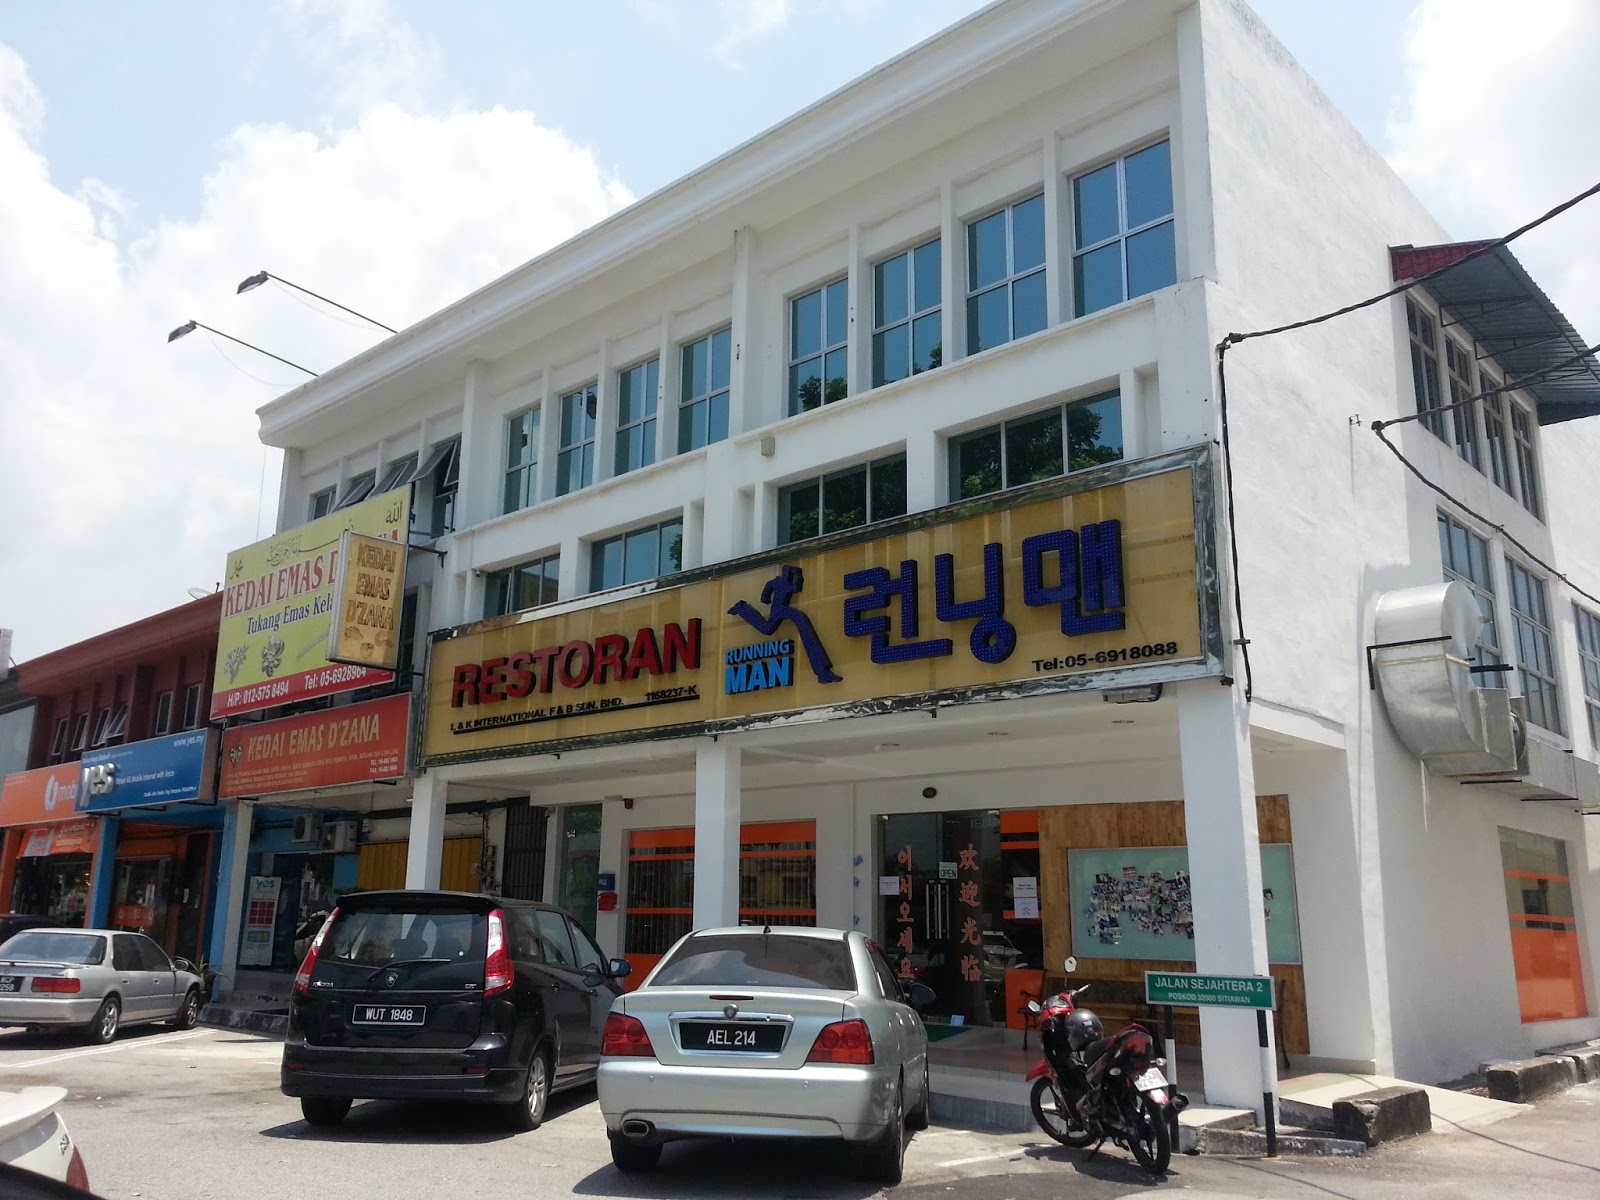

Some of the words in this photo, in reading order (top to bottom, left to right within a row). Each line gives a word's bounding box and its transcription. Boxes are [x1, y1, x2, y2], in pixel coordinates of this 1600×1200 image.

[357, 543, 396, 572] KEDAI
[225, 573, 274, 617] KEDAI
[276, 555, 323, 601] EMAS
[356, 573, 391, 600] EMAS
[843, 518, 1126, 664] 런닝맨
[247, 612, 281, 634] Tukang
[283, 604, 310, 624] Emas
[346, 600, 393, 630] D'ZANA
[451, 618, 702, 708] RESTORAN
[725, 639, 794, 664] RUNNING
[1032, 641, 1178, 672] Tel:05-6918088
[243, 685, 270, 704] 012-575
[271, 680, 289, 698] 8494
[304, 675, 319, 690] Tel:
[725, 656, 794, 695] MAN
[474, 709, 546, 728] INTERNATIONAL
[576, 701, 599, 712] SDN.
[600, 697, 624, 709] BHD.
[174, 735, 204, 747] www.yes.my
[248, 732, 284, 761] KEDAI
[289, 724, 324, 753] EMAS
[328, 714, 380, 748] D'ZANA
[80, 763, 116, 807] yes
[256, 880, 275, 889] yes
[940, 869, 957, 878] OPEN
[959, 844, 982, 981] 欢迎光临
[1155, 977, 1188, 988] JALAN
[1190, 979, 1254, 992] SEJAHTERA
[1256, 981, 1263, 992] 2
[1168, 992, 1196, 1001] POSKOD
[366, 1007, 385, 1021] WUT
[390, 1007, 413, 1021] 1848
[706, 1029, 732, 1045] AEL
[734, 1030, 756, 1046] 214
